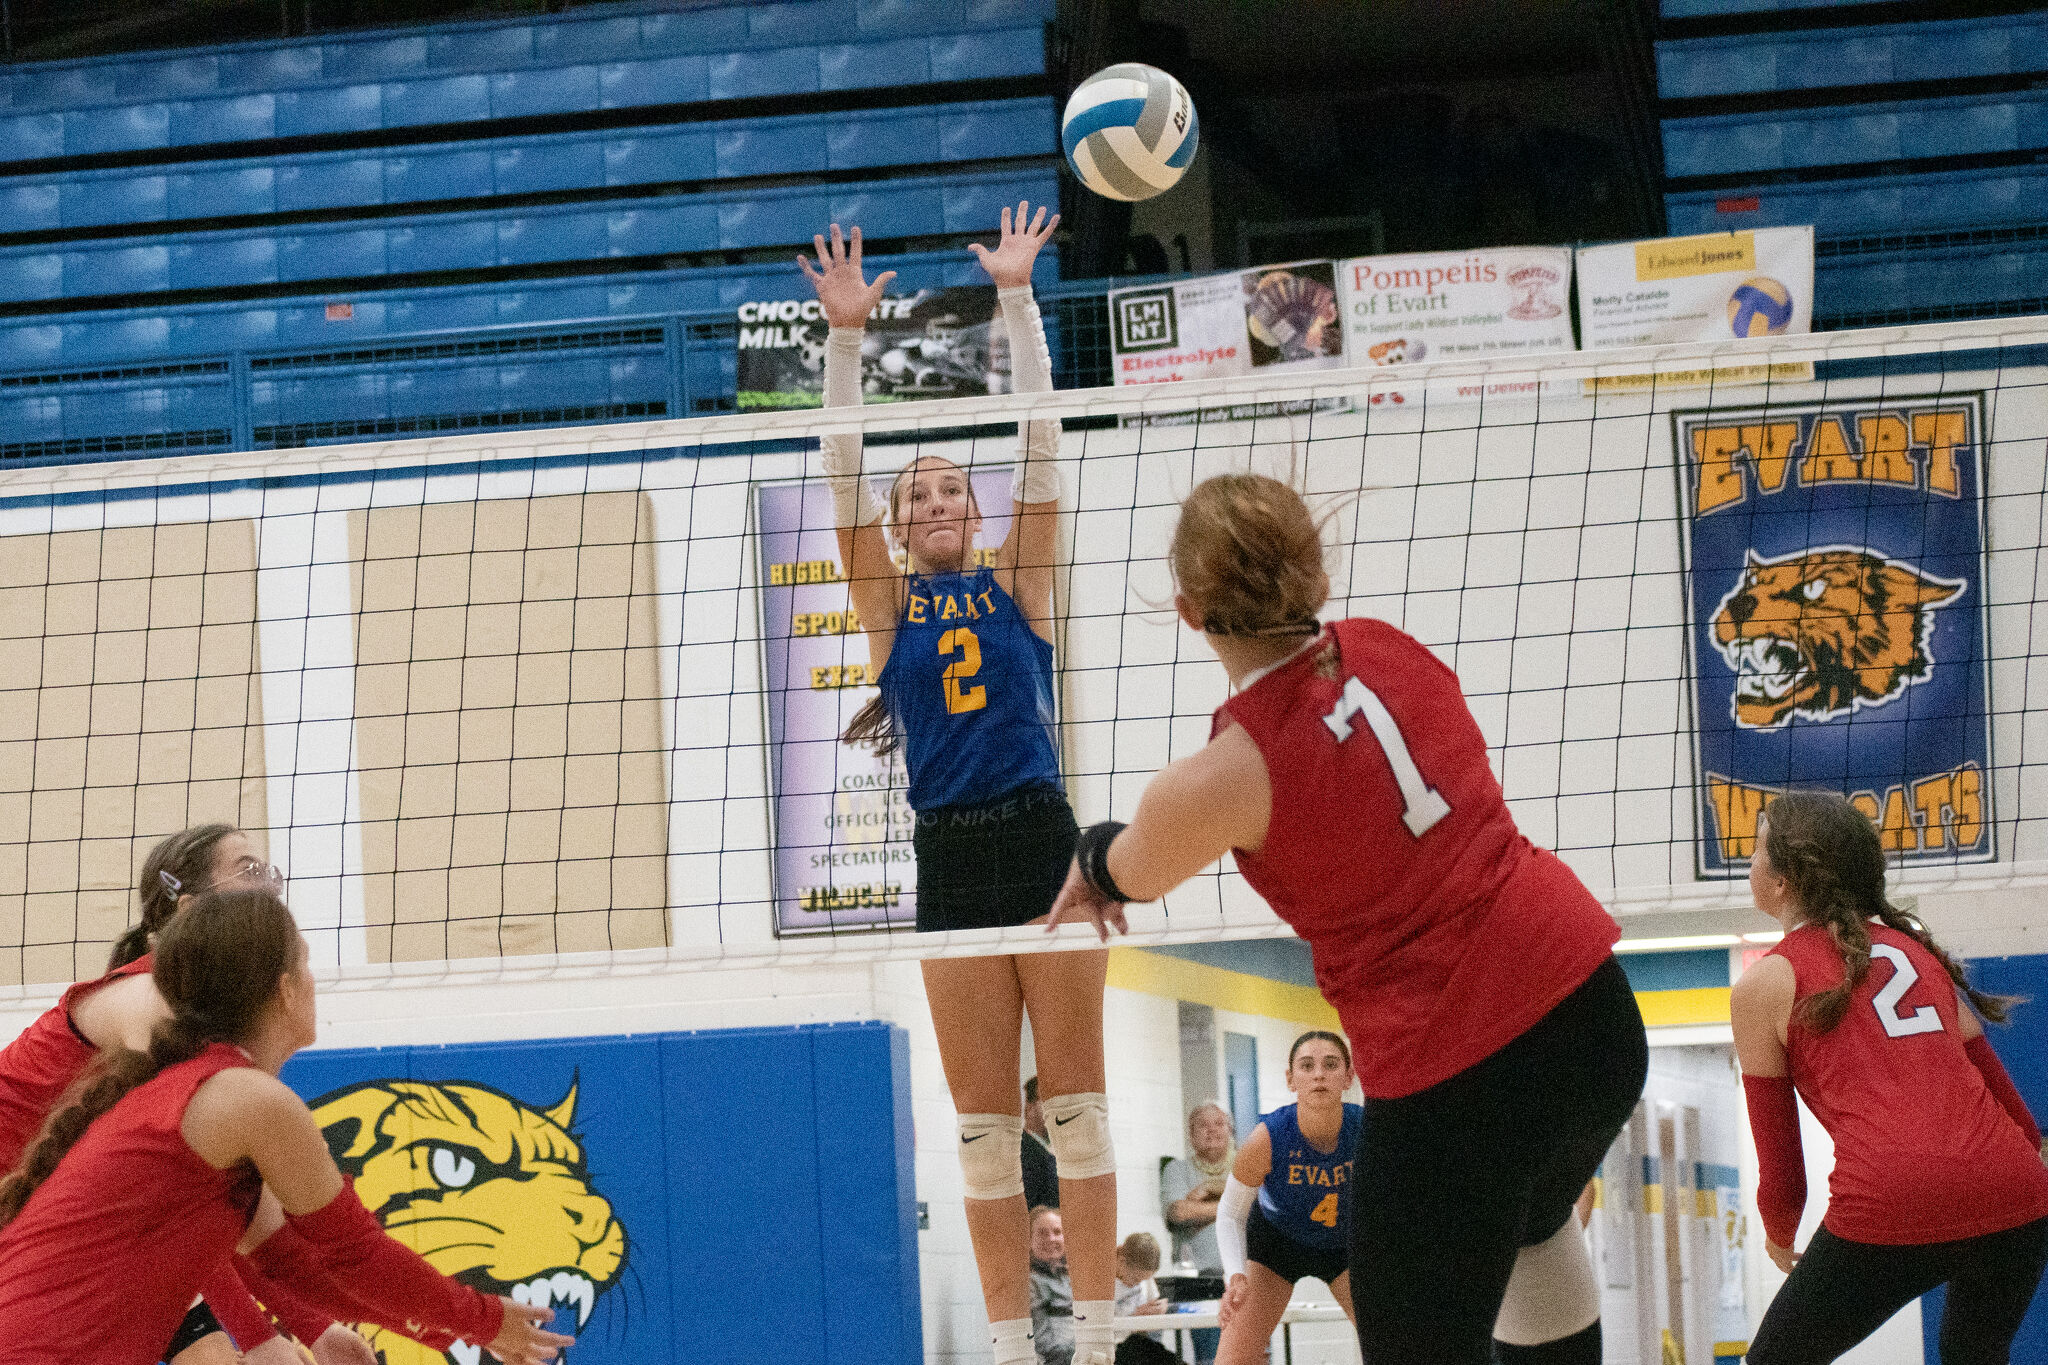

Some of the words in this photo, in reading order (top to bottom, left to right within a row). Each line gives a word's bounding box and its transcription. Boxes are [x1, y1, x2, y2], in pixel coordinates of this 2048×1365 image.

[1353, 257, 1499, 295] Pompeiis
[738, 301, 913, 323] CHOCTE
[1353, 295, 1377, 316] of
[1387, 292, 1449, 315] Evart
[738, 325, 810, 350] MILK
[1122, 346, 1237, 372] Electrolyte
[1691, 408, 1969, 516] EVART
[937, 626, 988, 715] 2
[1322, 675, 1452, 838] 7
[843, 771, 907, 790] COACHE
[824, 809, 912, 829] OFFICIALS
[811, 848, 911, 870] SPECTATORS
[1869, 943, 1945, 1038] 2
[1310, 1193, 1339, 1228] 4
